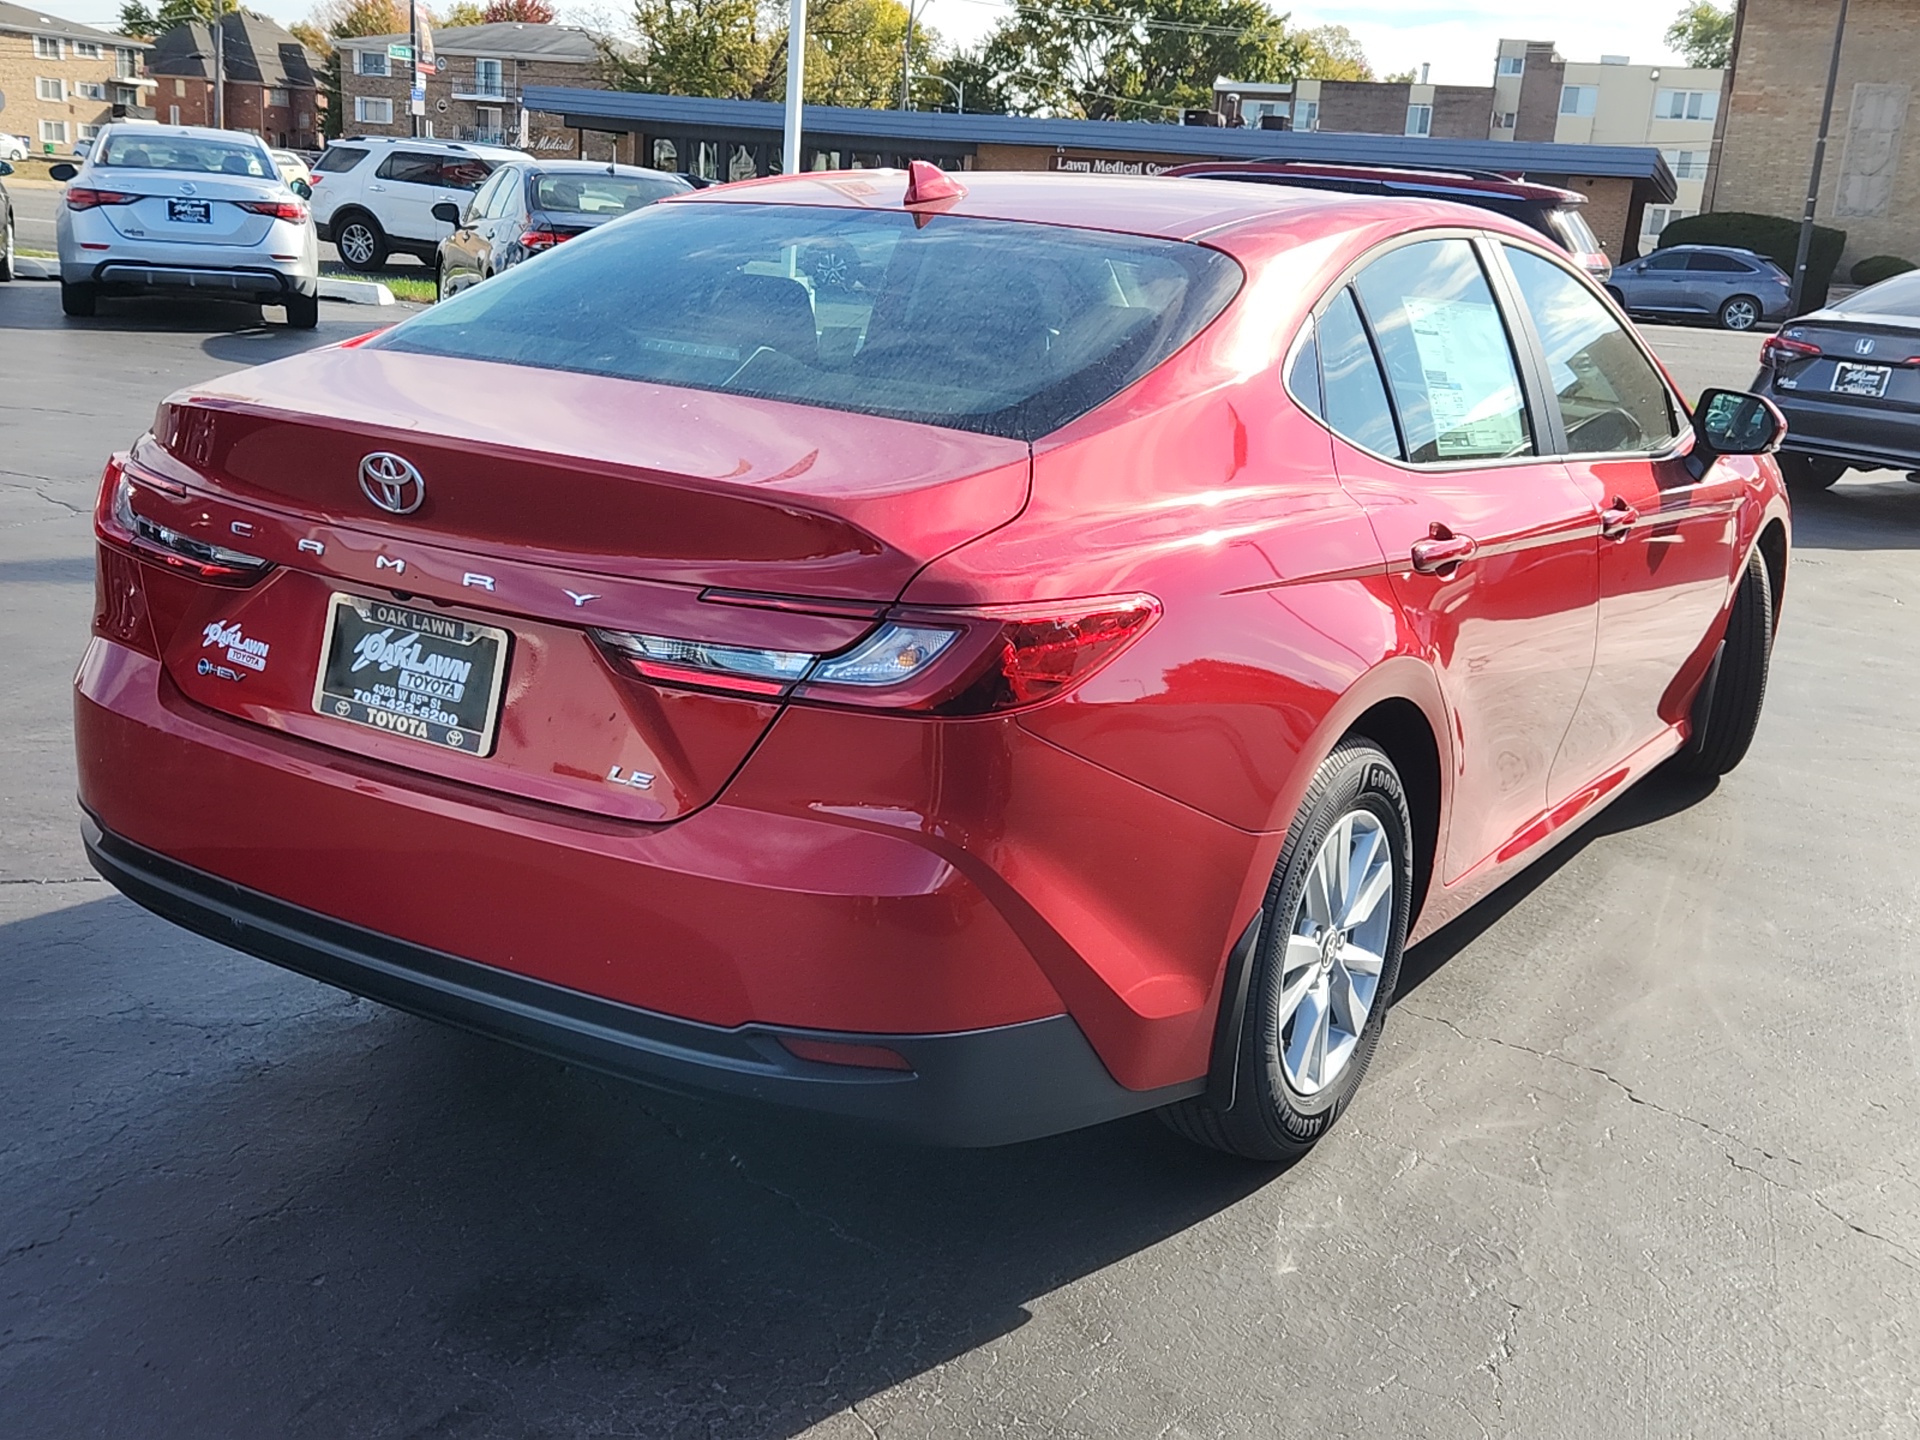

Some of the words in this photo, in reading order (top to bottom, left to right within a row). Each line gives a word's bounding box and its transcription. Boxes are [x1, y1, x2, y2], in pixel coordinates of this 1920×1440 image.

[535, 135, 574, 151] Medical
[1057, 157, 1090, 172] Lawn
[1093, 160, 1142, 175] Medical
[230, 520, 602, 607] CAMRY
[377, 607, 408, 627] OAK
[412, 614, 456, 638] LAWN
[232, 651, 260, 667] TOYOTA
[209, 663, 246, 682] HEV
[407, 673, 456, 697] TOYOTA
[353, 689, 459, 726] 708-423-5200
[372, 683, 397, 698] 4320
[398, 689, 409, 702] W
[430, 698, 442, 710] St
[366, 707, 428, 738] TOYOTA
[606, 765, 655, 790] LE
